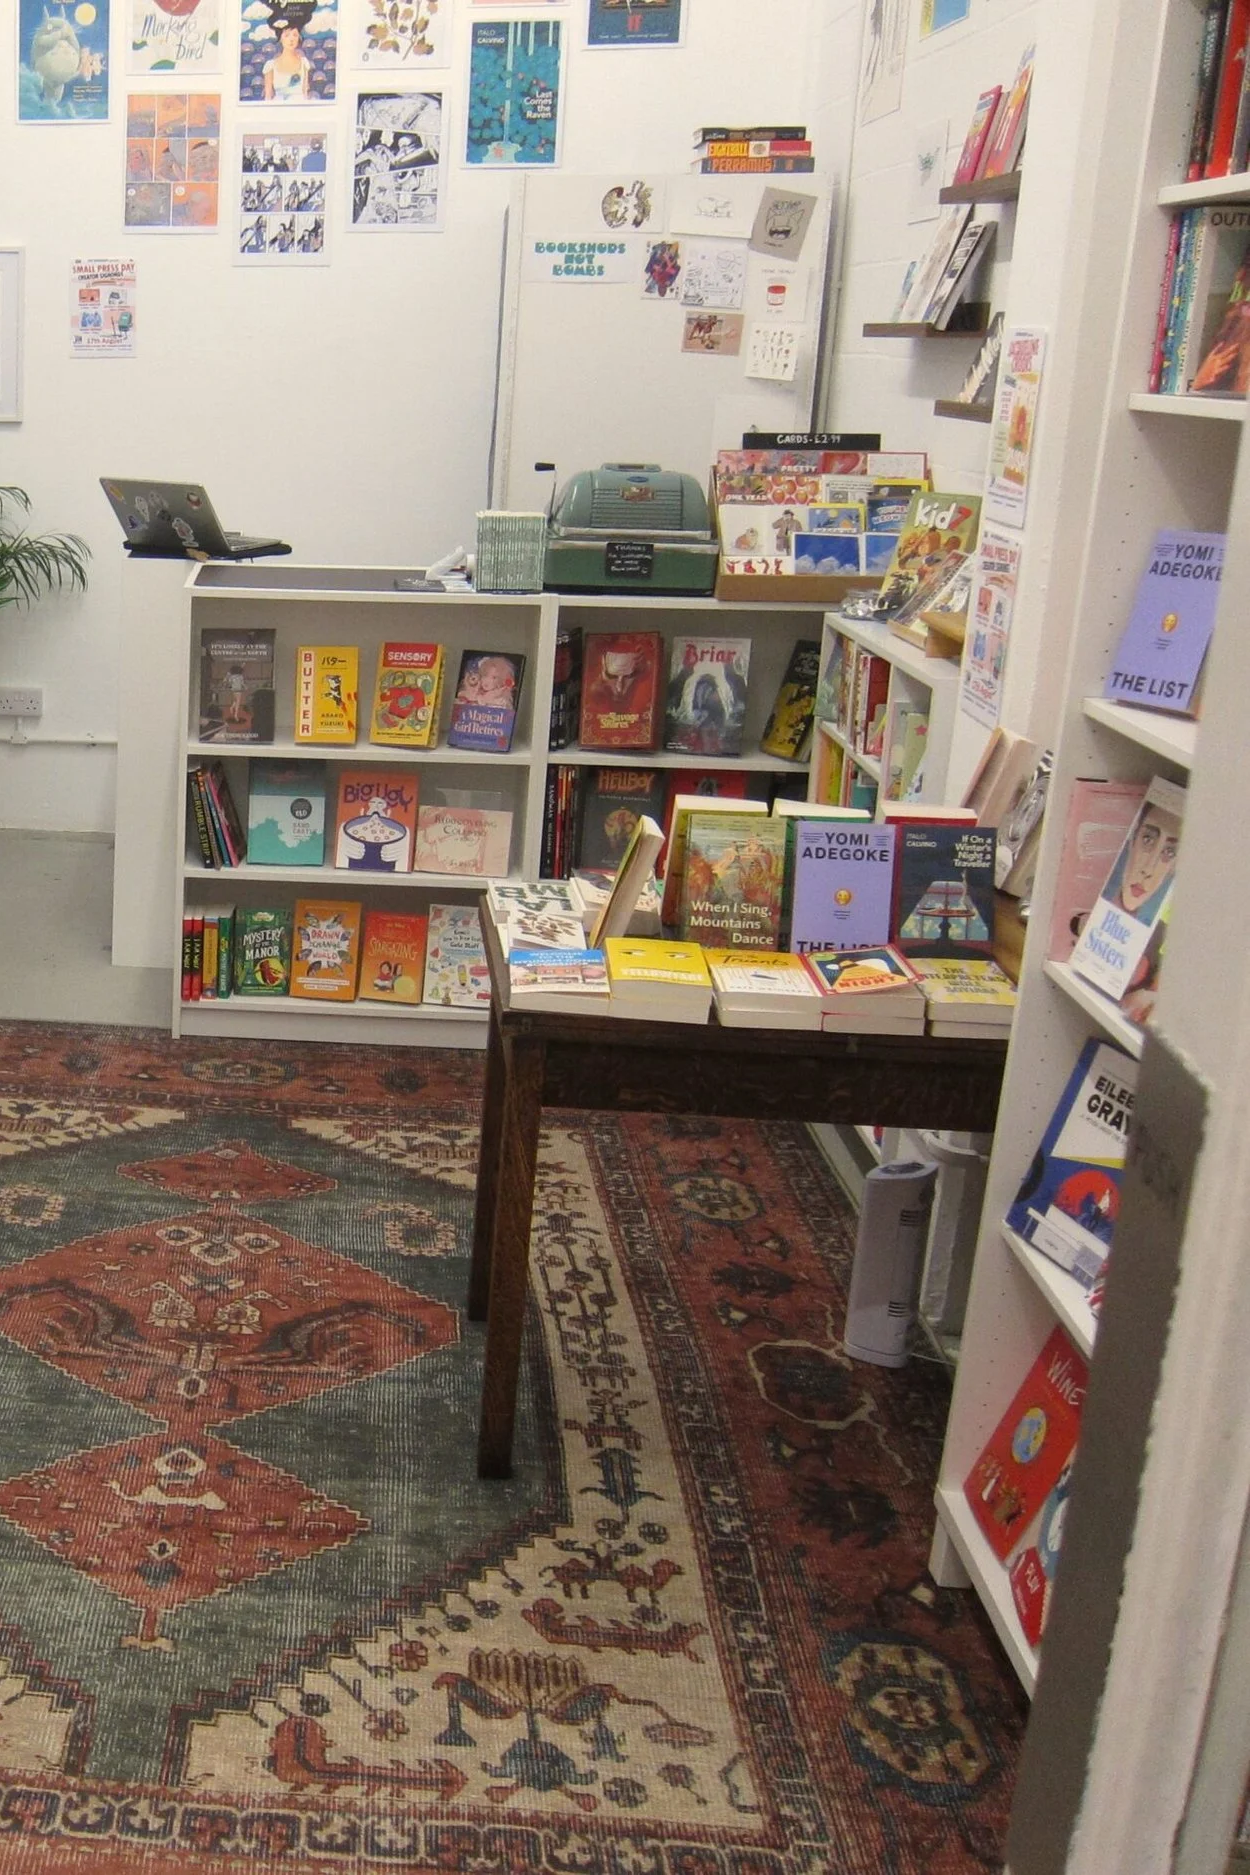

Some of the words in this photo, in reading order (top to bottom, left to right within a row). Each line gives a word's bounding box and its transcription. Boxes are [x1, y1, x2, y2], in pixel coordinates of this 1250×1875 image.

[526, 111, 551, 119] Raven
[564, 253, 595, 265] NOT
[72, 264, 95, 273] SMALL
[98, 264, 119, 272] PRESS
[121, 264, 135, 272] DAY
[552, 264, 606, 277] BOMBS
[777, 435, 808, 444] CARDS
[1174, 544, 1215, 562] YOMI
[388, 652, 433, 662] SENSORY
[684, 643, 737, 665] Briar
[321, 656, 347, 666] バター
[1110, 671, 1149, 694] THE
[1148, 678, 1191, 700] LIST
[301, 652, 313, 734] BUTTER
[467, 709, 504, 723] Magical
[471, 724, 504, 736] Retires
[598, 770, 656, 793] HELLBOY
[824, 832, 870, 846] YOMI
[961, 835, 968, 843] If
[969, 835, 984, 844] On
[802, 846, 890, 862] ADEGOKE
[954, 843, 992, 852] Winter's
[957, 851, 982, 861] Night
[953, 859, 991, 869] Traveller
[691, 901, 731, 914] When
[690, 915, 761, 930] Mountains
[1101, 910, 1131, 945] Blue
[243, 927, 285, 946] MYSTERY
[311, 929, 340, 940] DRAWN
[732, 932, 773, 945] Dance
[796, 940, 835, 953] THE
[1085, 927, 1125, 970] Sisters
[245, 946, 280, 961] MANOR
[838, 976, 899, 988] NIGHT
[1046, 1351, 1087, 1406] WINE
